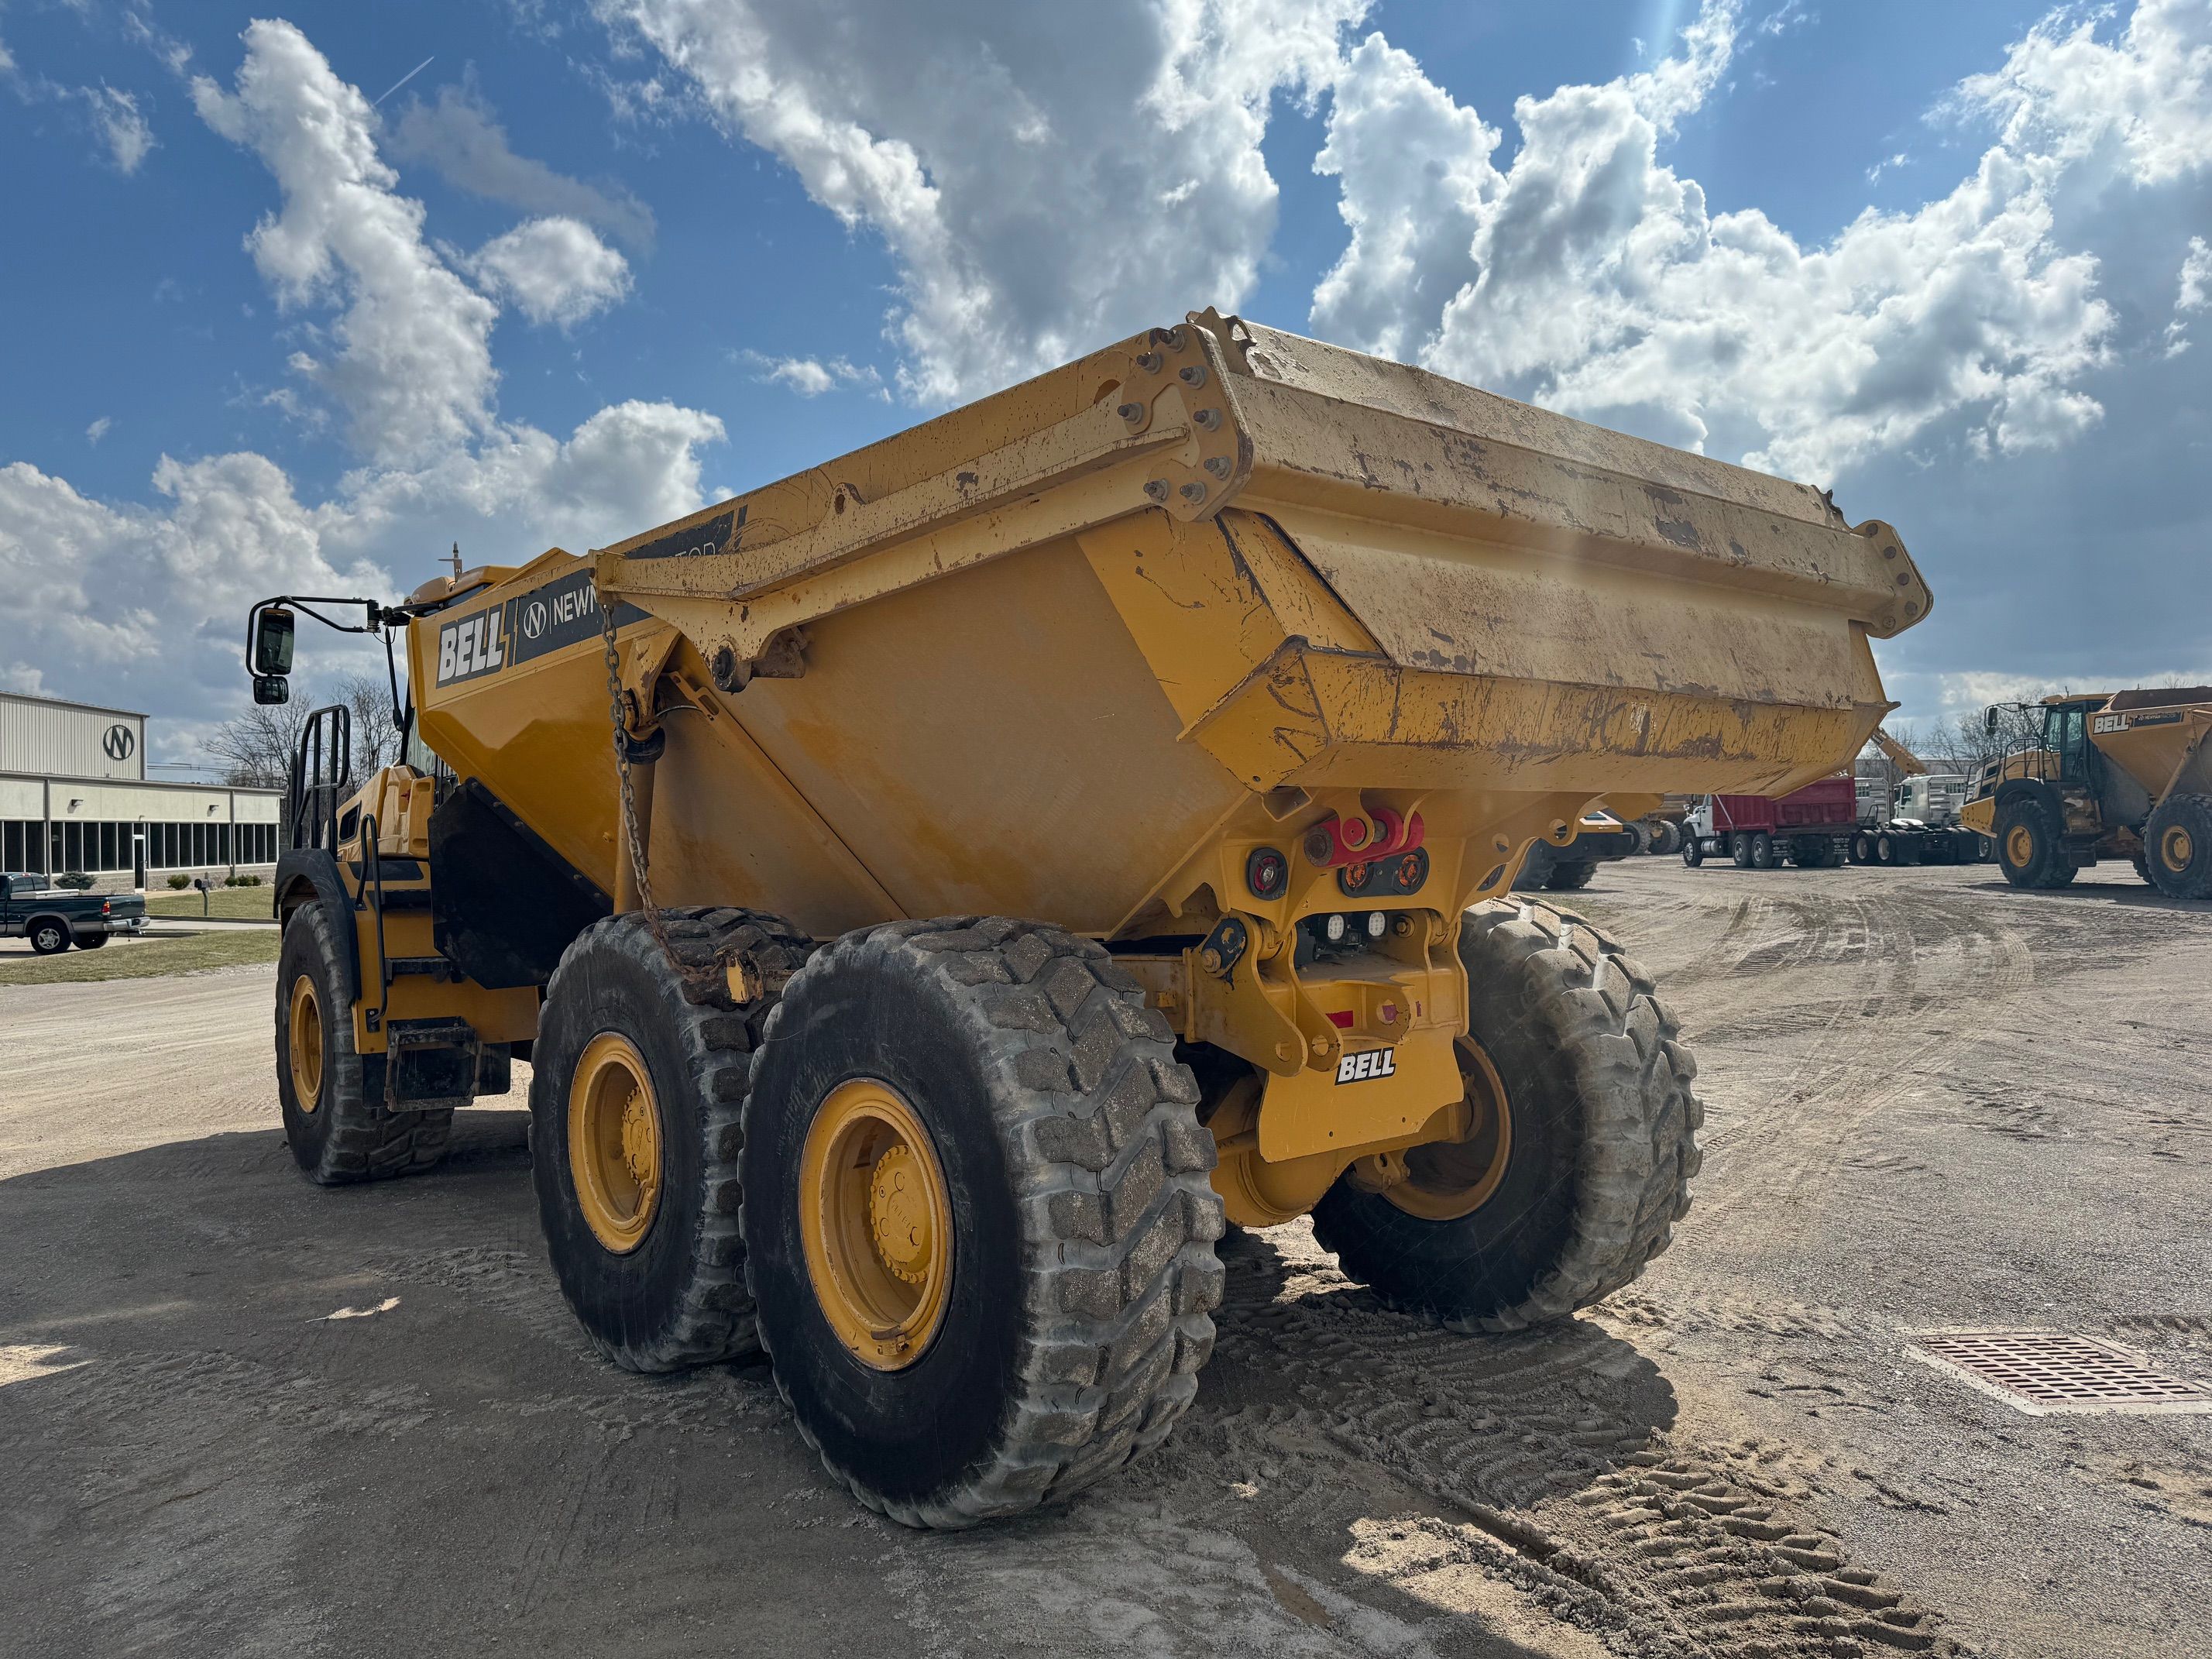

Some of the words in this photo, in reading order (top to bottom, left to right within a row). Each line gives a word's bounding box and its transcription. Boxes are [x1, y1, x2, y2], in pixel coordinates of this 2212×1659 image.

[438, 611, 503, 682] BELL
[2094, 713, 2129, 733] BELL
[1338, 1049, 1395, 1082] BELL
